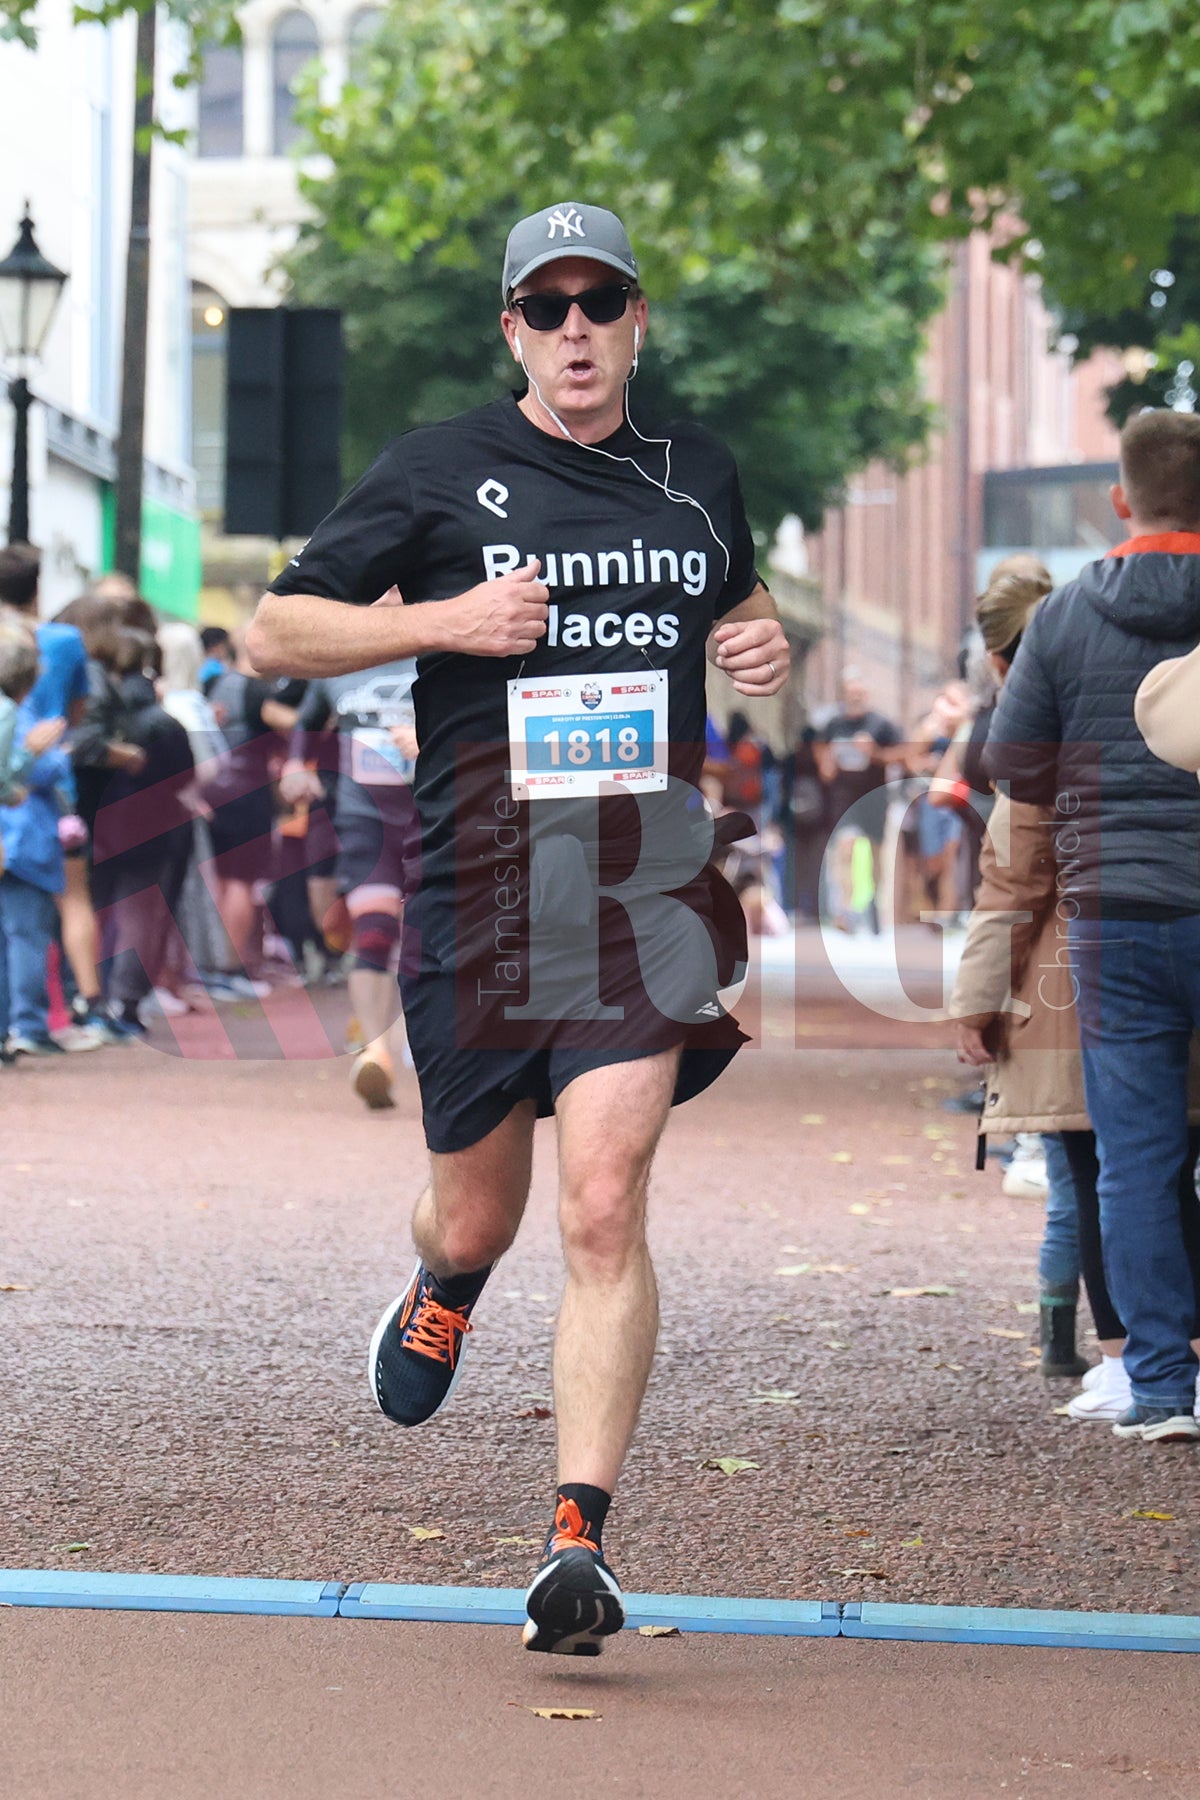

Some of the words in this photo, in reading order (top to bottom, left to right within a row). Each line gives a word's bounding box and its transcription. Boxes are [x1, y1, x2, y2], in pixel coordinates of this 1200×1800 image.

[547, 208, 586, 239] NY
[482, 538, 707, 596] Running
[547, 604, 680, 648] laces
[531, 689, 562, 699] SPAR
[620, 685, 648, 694] SPAR
[543, 726, 640, 766] 1818
[534, 776, 565, 785] SPAR
[622, 771, 649, 781] SPAR
